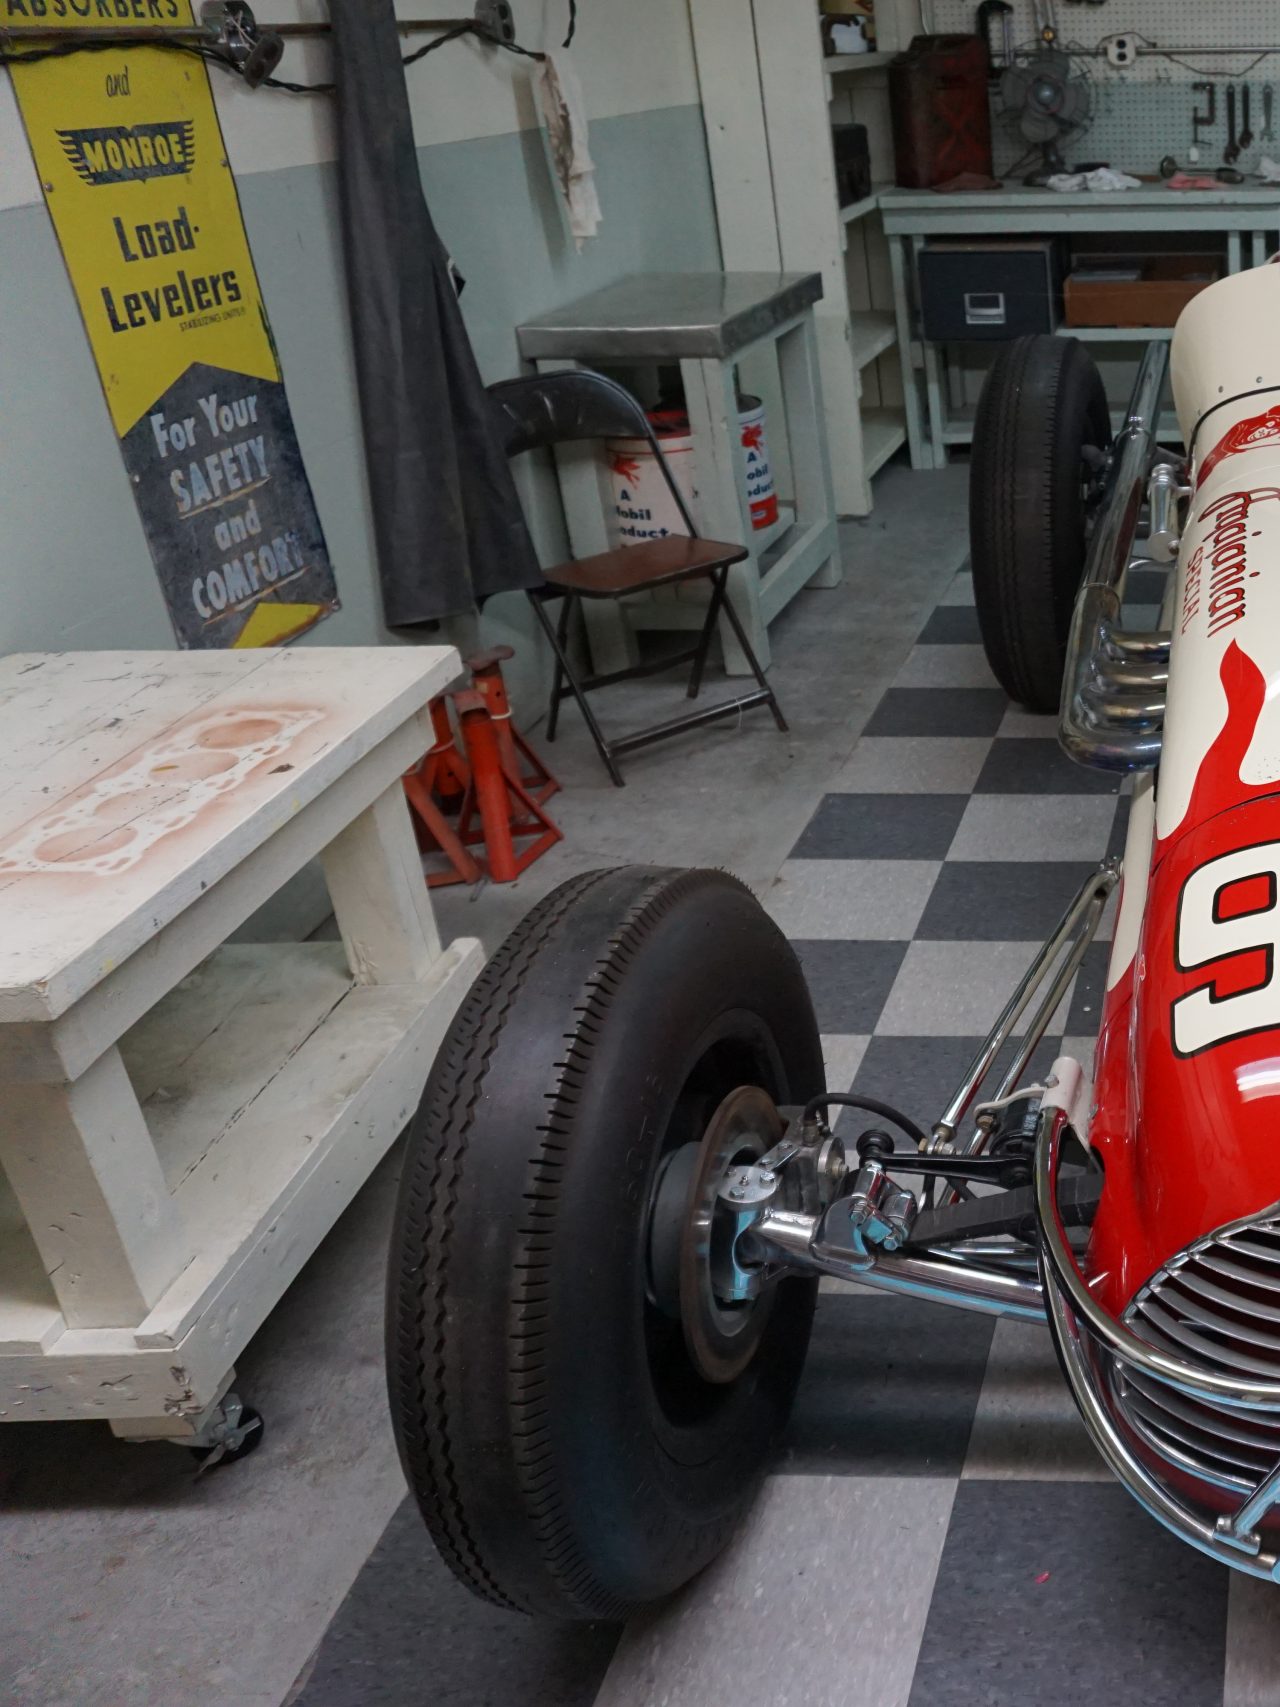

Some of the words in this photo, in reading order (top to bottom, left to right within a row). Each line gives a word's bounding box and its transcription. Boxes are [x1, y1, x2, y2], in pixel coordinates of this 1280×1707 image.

[105, 64, 131, 97] and
[81, 132, 183, 174] MONROE
[100, 269, 243, 333] Levelers
[150, 411, 196, 458] For
[197, 393, 258, 438] Your
[169, 435, 270, 513] SAFETY
[746, 464, 769, 481] obil
[747, 451, 757, 463] A
[620, 488, 631, 502] A
[214, 498, 262, 551] and
[191, 530, 306, 619] COMFORT
[1181, 545, 1204, 637] SPECIAL
